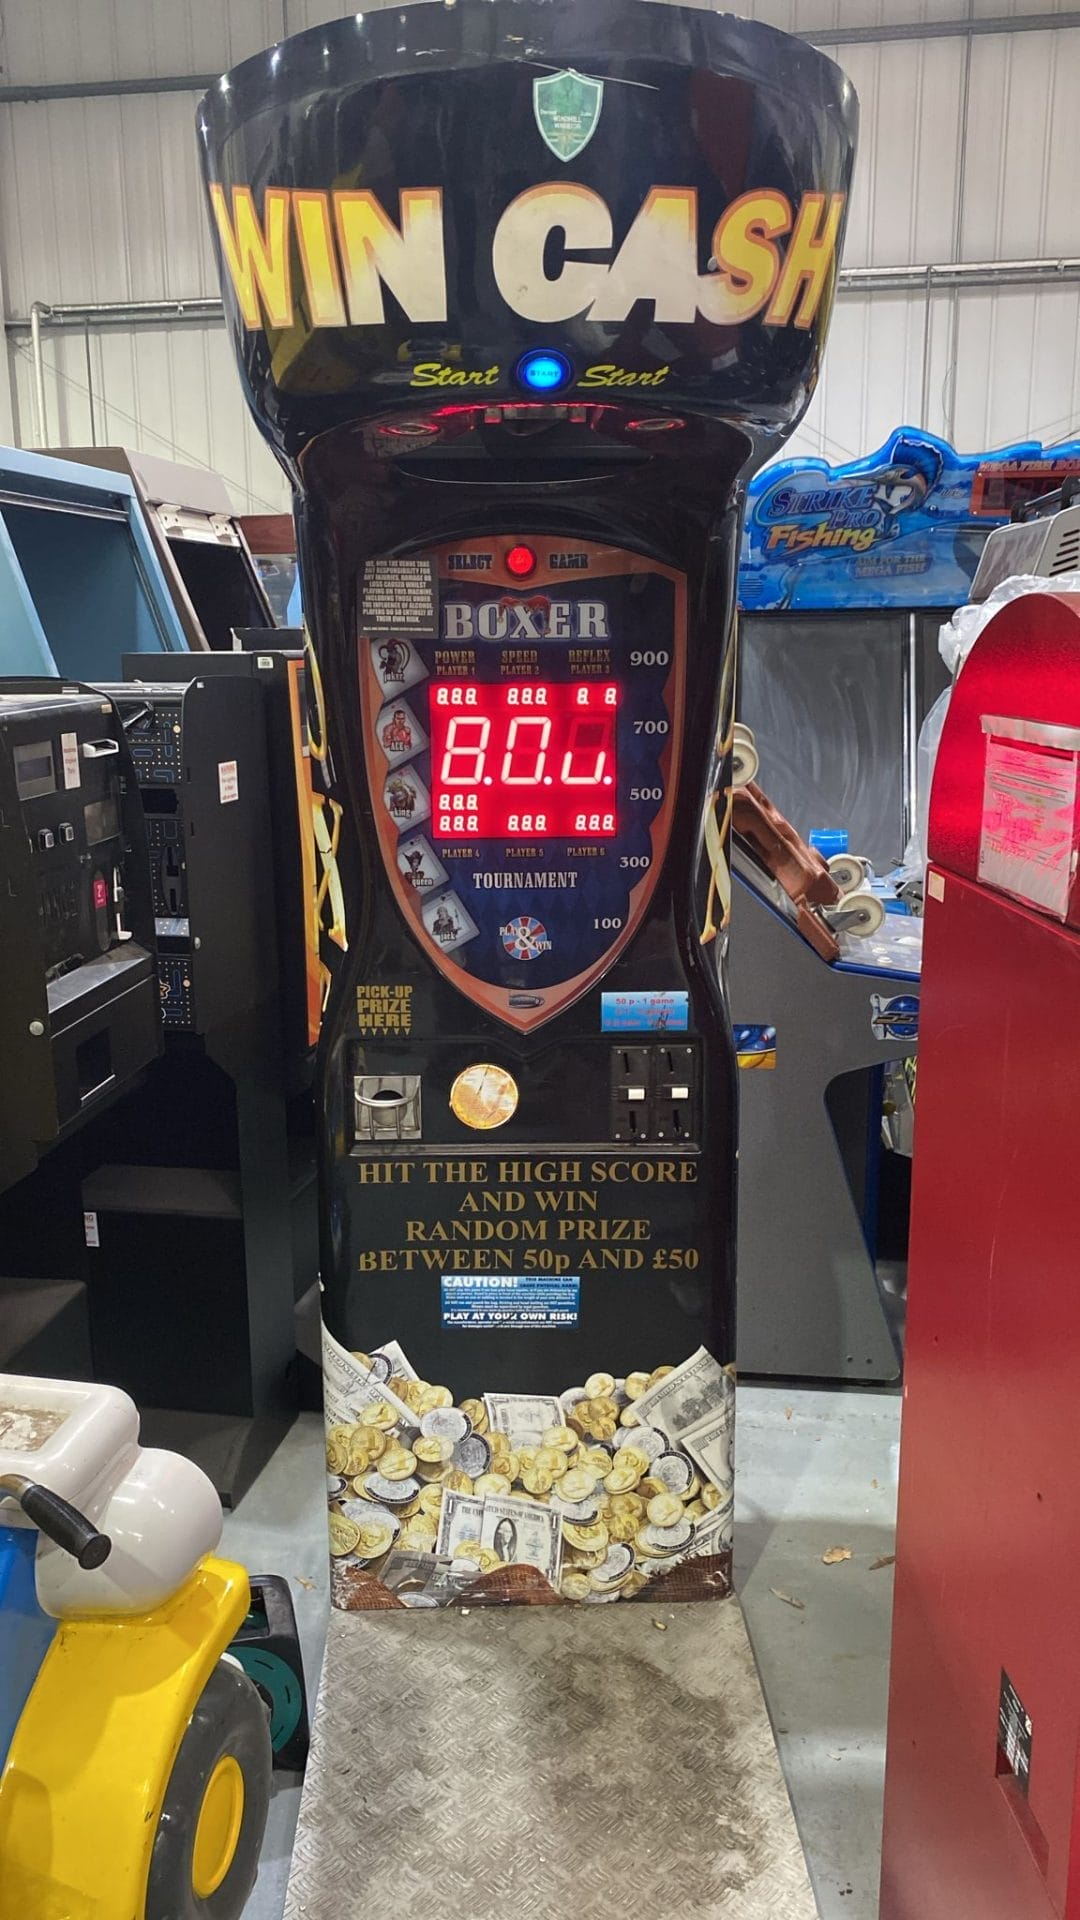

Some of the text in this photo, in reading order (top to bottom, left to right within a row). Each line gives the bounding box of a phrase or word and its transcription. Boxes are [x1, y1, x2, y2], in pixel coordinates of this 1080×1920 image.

[209, 181, 846, 331] WIN CASH
[410, 362, 500, 387] Start
[530, 369, 561, 378] START
[576, 364, 670, 387] Start
[768, 485, 879, 517] STRIKE
[828, 508, 881, 529] PRO
[766, 521, 877, 552] Fishing
[447, 552, 589, 571] SELECT GAME
[443, 602, 609, 640] BOXER
[434, 650, 476, 664] POWER
[501, 650, 538, 664] SPEED
[568, 649, 611, 663] REFLEX
[629, 650, 669, 666] 900
[436, 665, 469, 676] PLAYER
[500, 665, 540, 676] PLAYER 2
[570, 664, 610, 675] PLAYER 3
[383, 671, 405, 684] joker
[633, 719, 669, 735] 700
[390, 740, 405, 752] ACE
[629, 787, 663, 801] 500
[393, 808, 412, 819] king
[442, 848, 480, 858] PLAYER 4
[505, 847, 544, 858] PLAYER 5
[567, 846, 605, 857] PLAYER 6
[619, 856, 650, 868] 300
[411, 877, 434, 888] queen
[473, 871, 578, 889] TOURNAMENT
[593, 918, 622, 930] 100
[440, 930, 456, 943] jack
[514, 926, 541, 953] &
[356, 985, 413, 998] PICK-UP
[357, 999, 411, 1013] PRIZE
[650, 998, 675, 1006] game
[358, 1014, 411, 1027] HERE
[358, 1160, 698, 1184] HIT THE HIGH SCORE
[458, 1190, 598, 1212] AND WIN
[405, 1219, 651, 1242] RANDOM PRIZE
[358, 1248, 699, 1275] BETWEEN 50p AND £50
[443, 1276, 518, 1288] CAUTION!
[443, 1312, 470, 1321] PLAY
[472, 1312, 486, 1321] AT
[519, 1312, 546, 1321] OWN
[549, 1312, 578, 1321] RISK!
